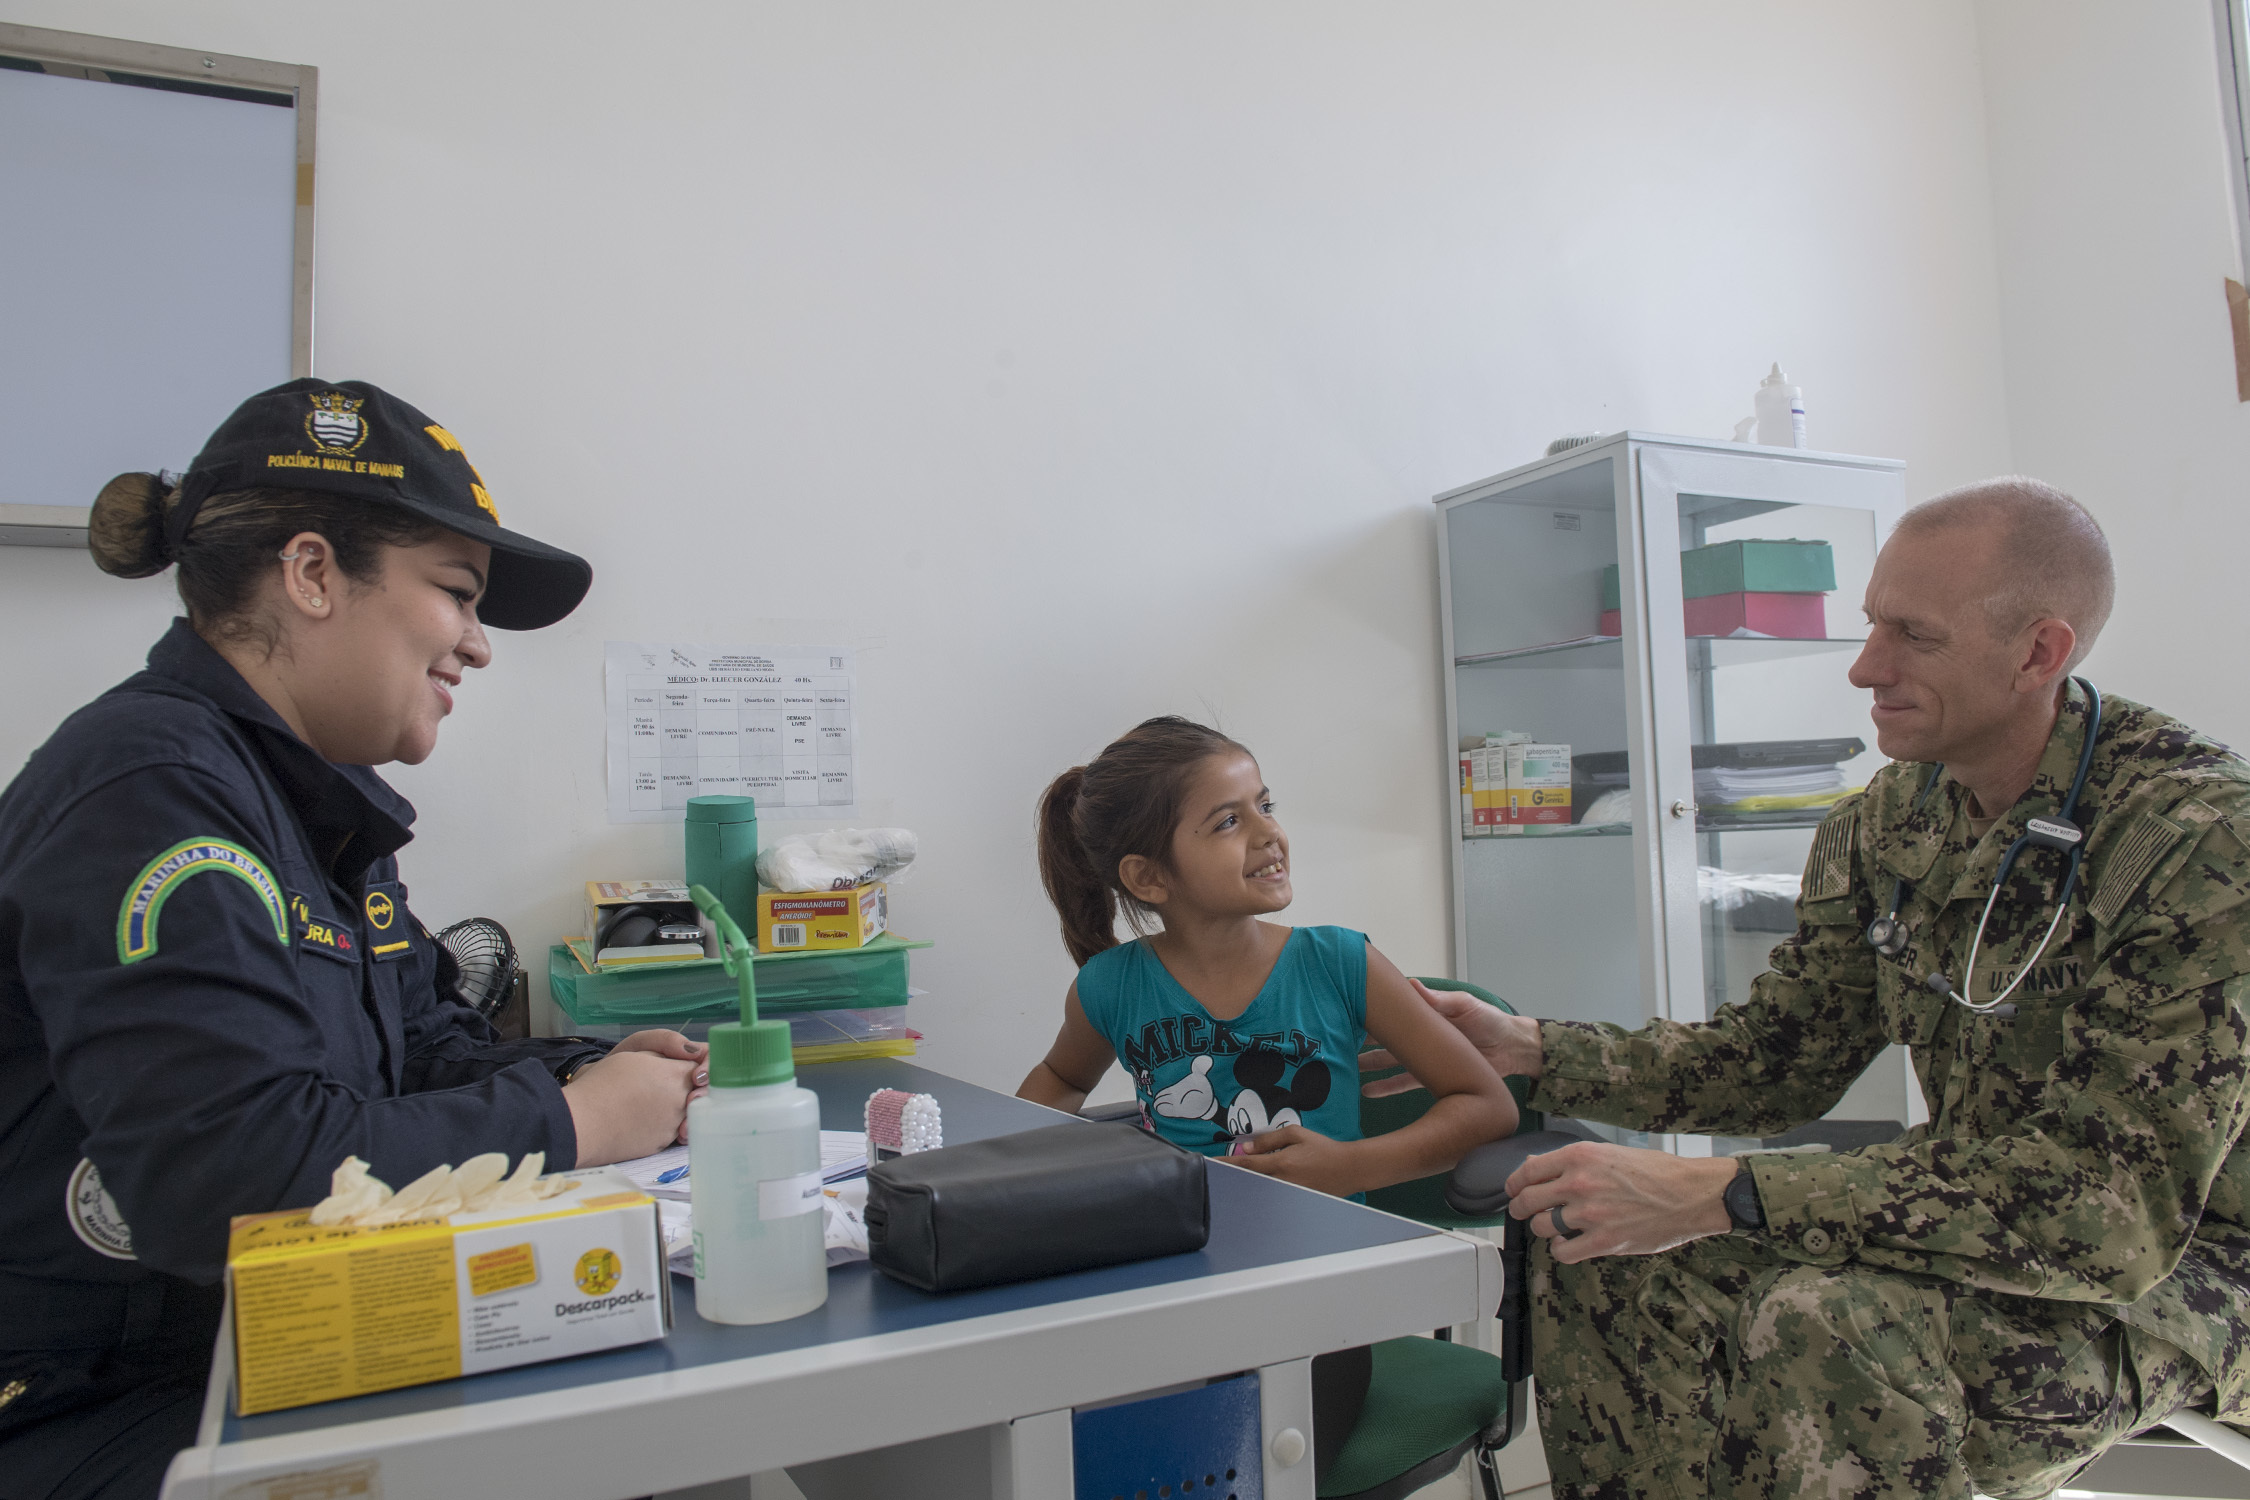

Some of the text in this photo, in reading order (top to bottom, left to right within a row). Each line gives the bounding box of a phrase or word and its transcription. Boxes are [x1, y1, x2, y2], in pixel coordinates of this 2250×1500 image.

[267, 450, 404, 479] POLICLÍNICA NAVAL DE MANAUS
[667, 675, 698, 683] MÉDICO:
[743, 675, 782, 683] GONZÁLEZ
[1532, 790, 1544, 805] G
[132, 847, 276, 914] MARINHA DO BRASIL
[774, 900, 846, 910] ESFIGMOMANÔMETRO
[779, 912, 813, 920] ANERÓIDE
[816, 930, 849, 939] Premium
[2023, 962, 2079, 991] NAVY
[1124, 1014, 1321, 1071] MICKEY
[85, 1215, 121, 1248] MARINHA
[556, 1290, 645, 1318] Descarpack
